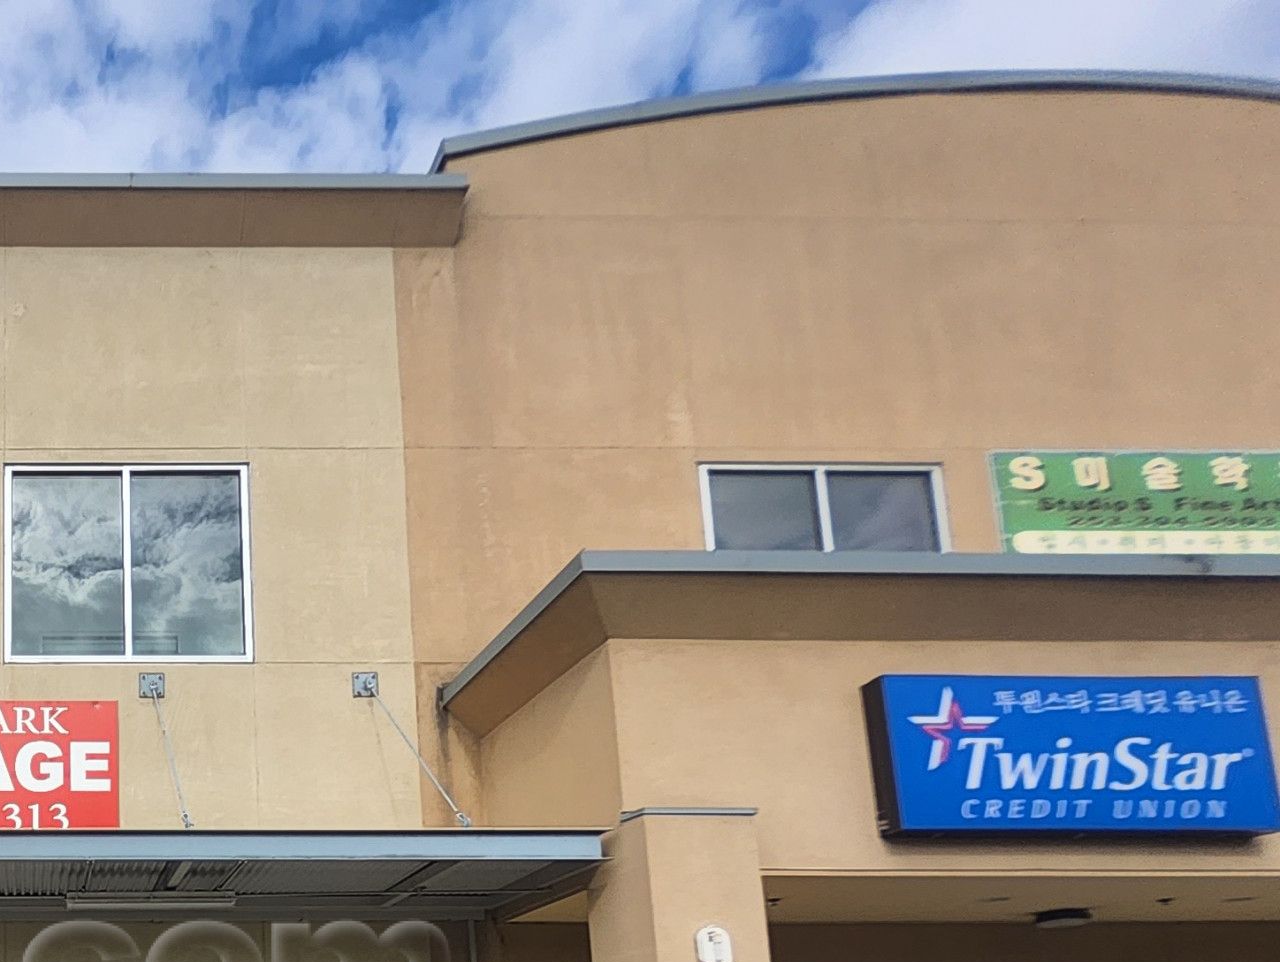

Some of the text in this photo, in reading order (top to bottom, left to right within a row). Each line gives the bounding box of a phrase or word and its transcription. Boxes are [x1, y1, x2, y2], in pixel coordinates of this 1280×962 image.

[957, 736, 1242, 791] TwinStar
[960, 798, 1228, 819] CREDIT UNION
